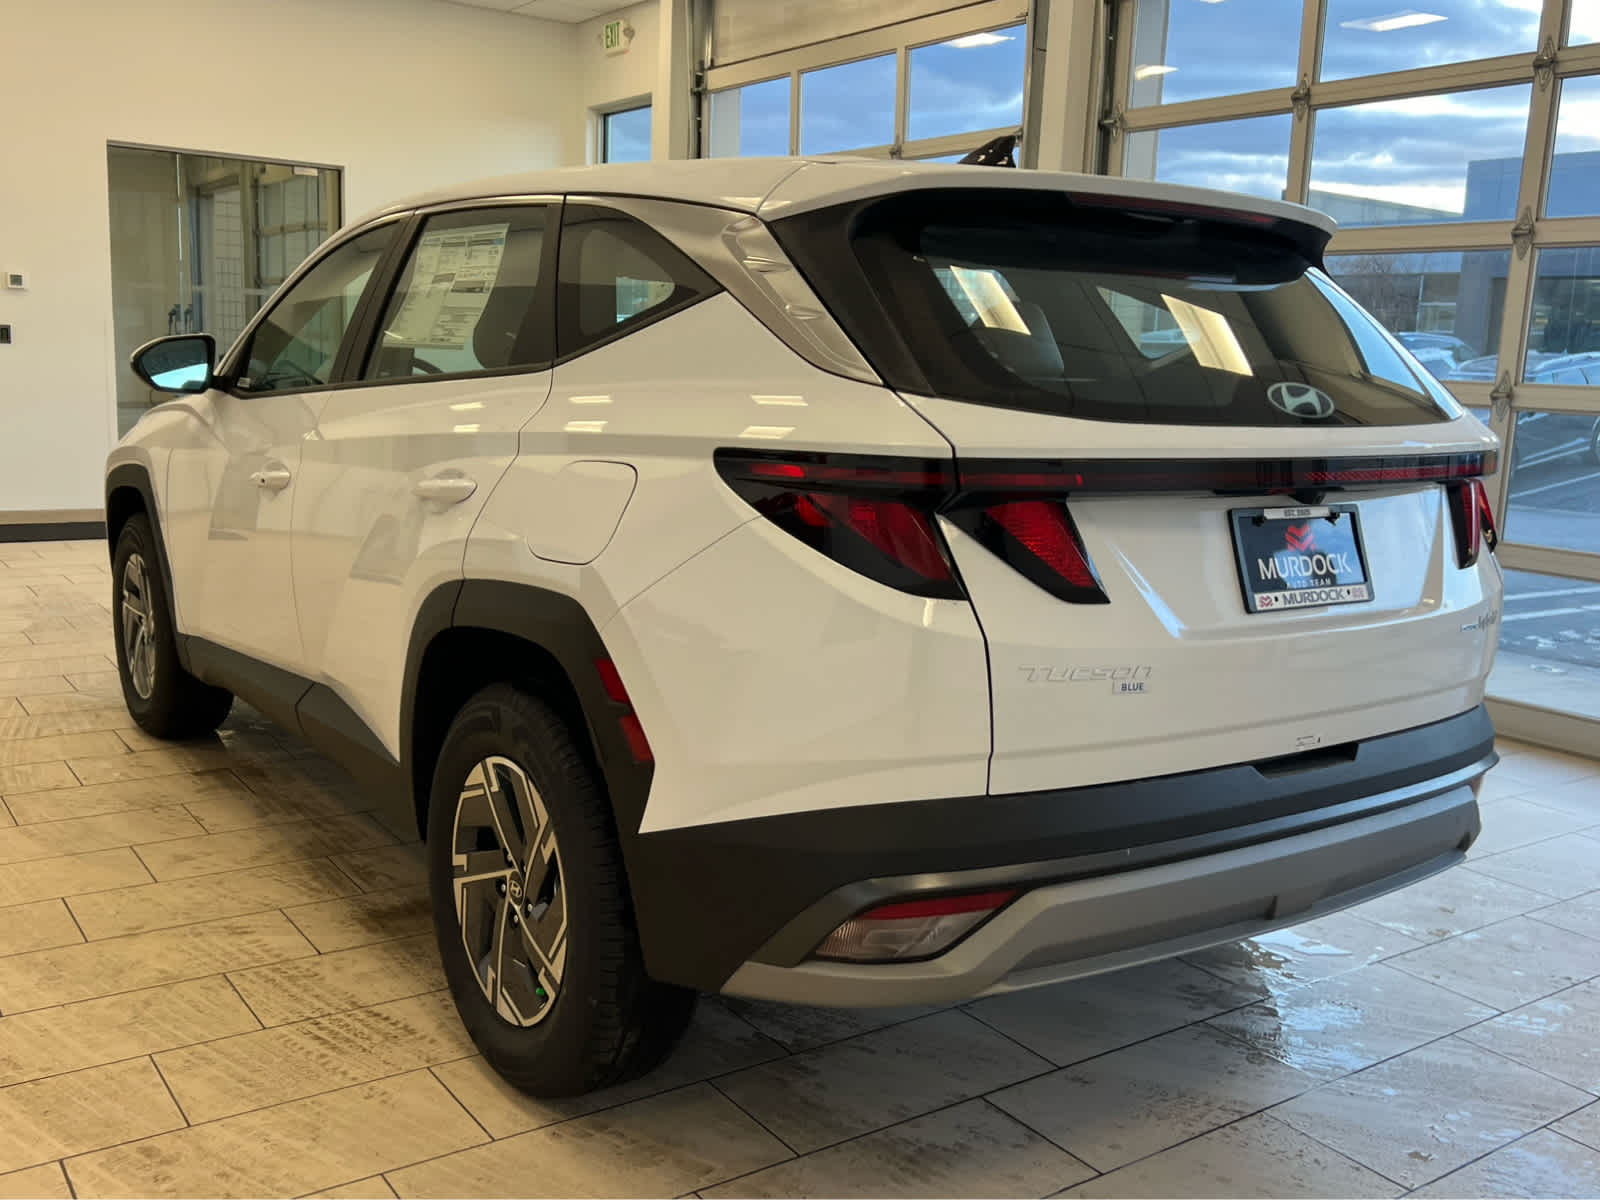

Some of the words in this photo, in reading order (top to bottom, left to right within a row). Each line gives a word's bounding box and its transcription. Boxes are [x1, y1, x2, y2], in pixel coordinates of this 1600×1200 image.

[605, 21, 620, 48] EXIT
[1257, 552, 1352, 580] MURDOCK
[1310, 578, 1331, 588] TEAM
[1283, 588, 1345, 606] MURDOCK
[1121, 682, 1145, 692] BLUE
